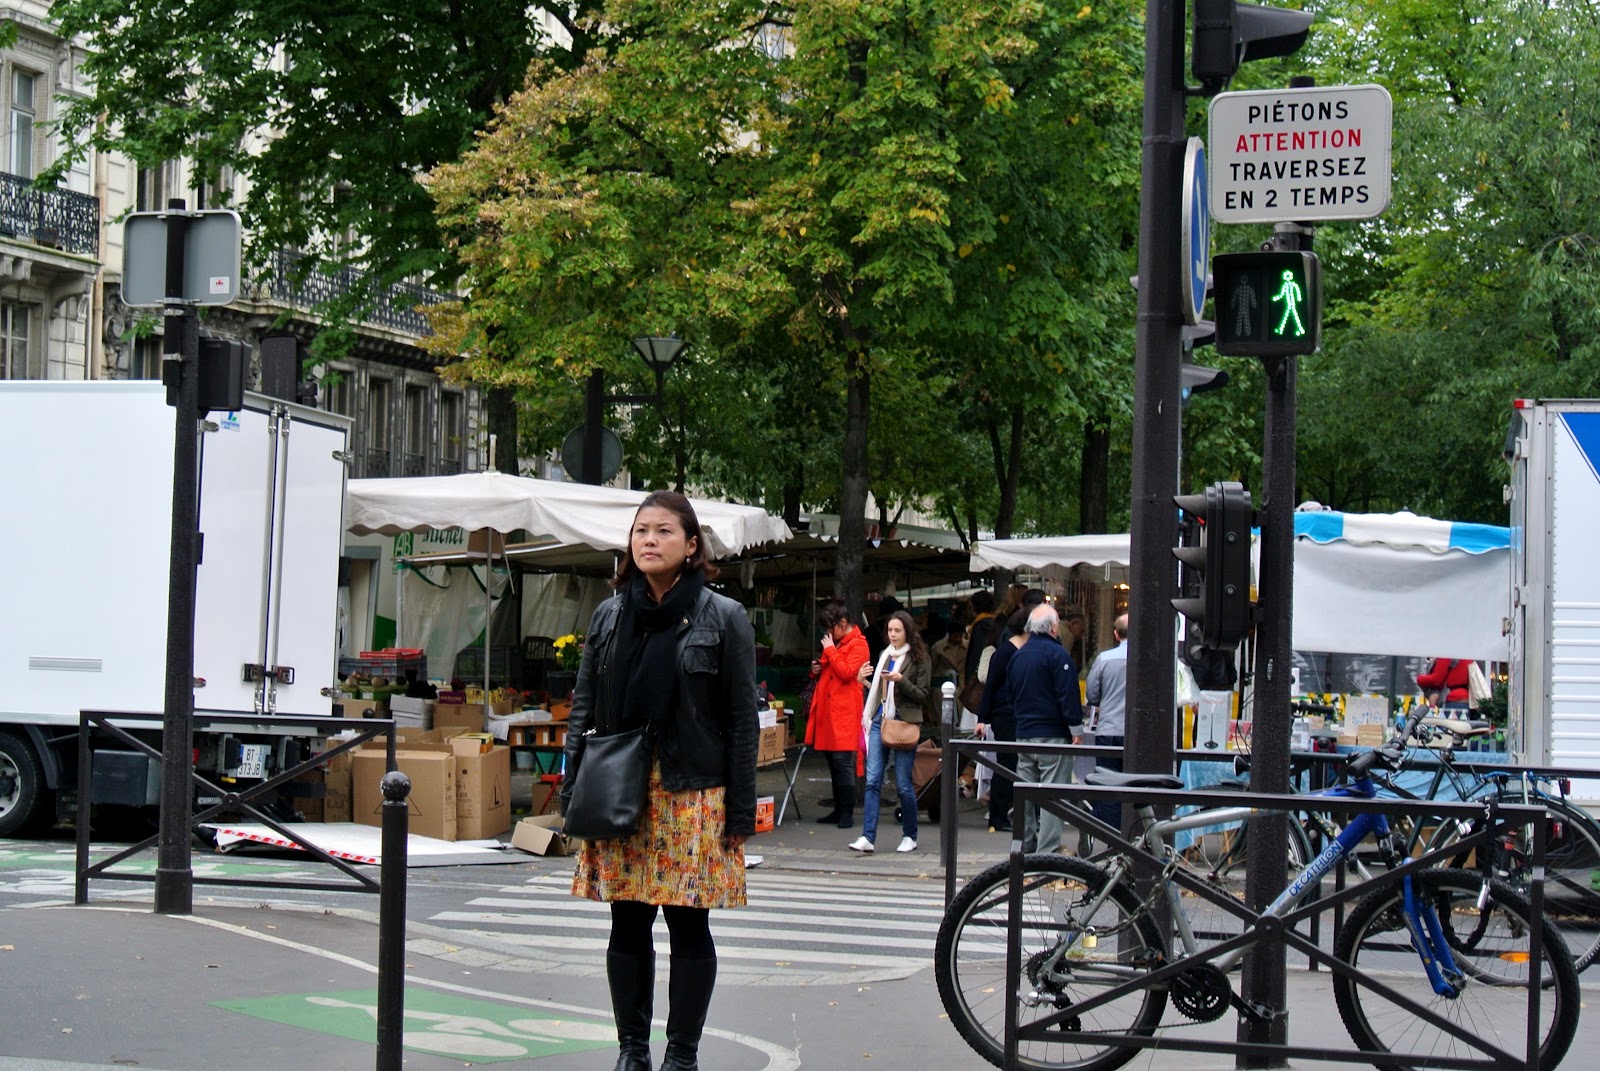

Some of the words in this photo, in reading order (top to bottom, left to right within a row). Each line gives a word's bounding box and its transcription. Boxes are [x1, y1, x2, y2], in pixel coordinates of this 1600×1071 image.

[1248, 100, 1348, 124] PIÉTONS
[1235, 128, 1361, 153] ATTENTION
[1230, 157, 1366, 181] TRAVERSEZ
[1225, 191, 1253, 209] EN
[1265, 190, 1278, 208] 2
[1290, 185, 1369, 206] TEMPS
[1288, 840, 1344, 897] DECATHLON
